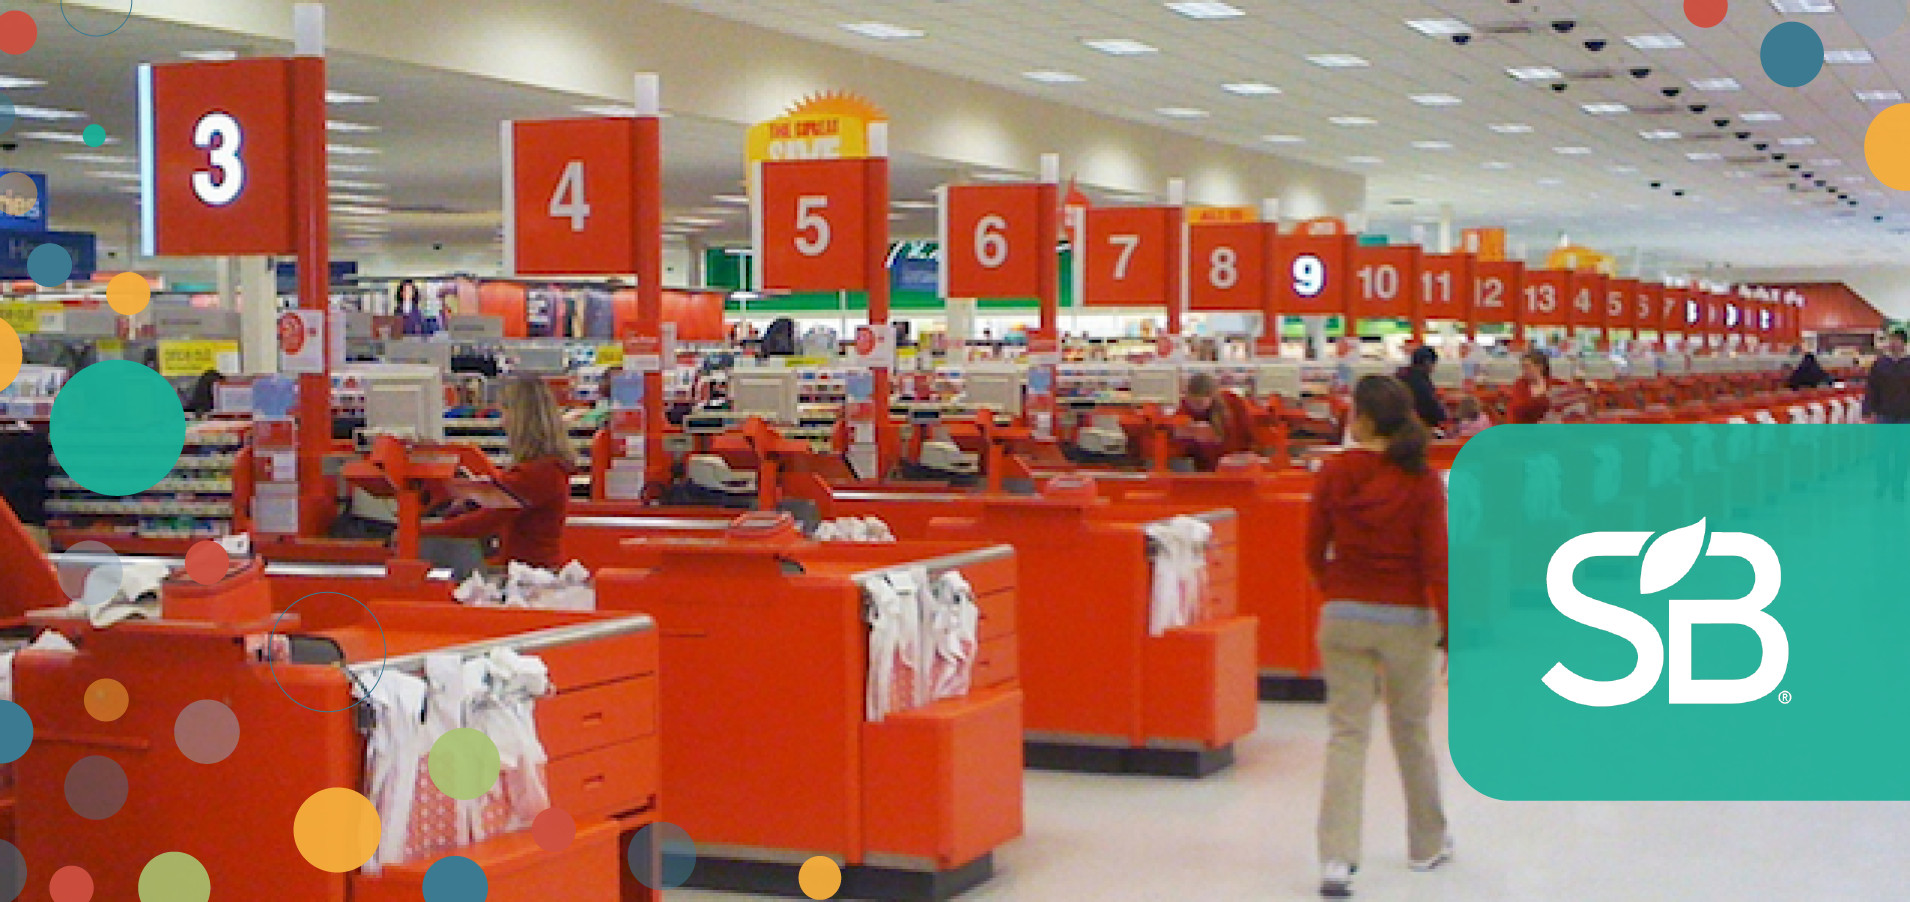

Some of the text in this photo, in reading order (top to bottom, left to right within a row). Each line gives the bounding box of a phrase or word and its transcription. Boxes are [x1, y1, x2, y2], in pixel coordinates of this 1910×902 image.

[191, 112, 246, 206] 3
[548, 161, 591, 231] 4
[794, 196, 831, 256] 5
[973, 215, 1008, 268] 6
[1109, 234, 1140, 279] 7
[1209, 247, 1237, 289] 8
[1291, 254, 1326, 297] 9
[1356, 264, 1399, 300] 10
[1421, 271, 1452, 304] 11
[1474, 277, 1505, 308] 12
[1524, 284, 1558, 314] 13
